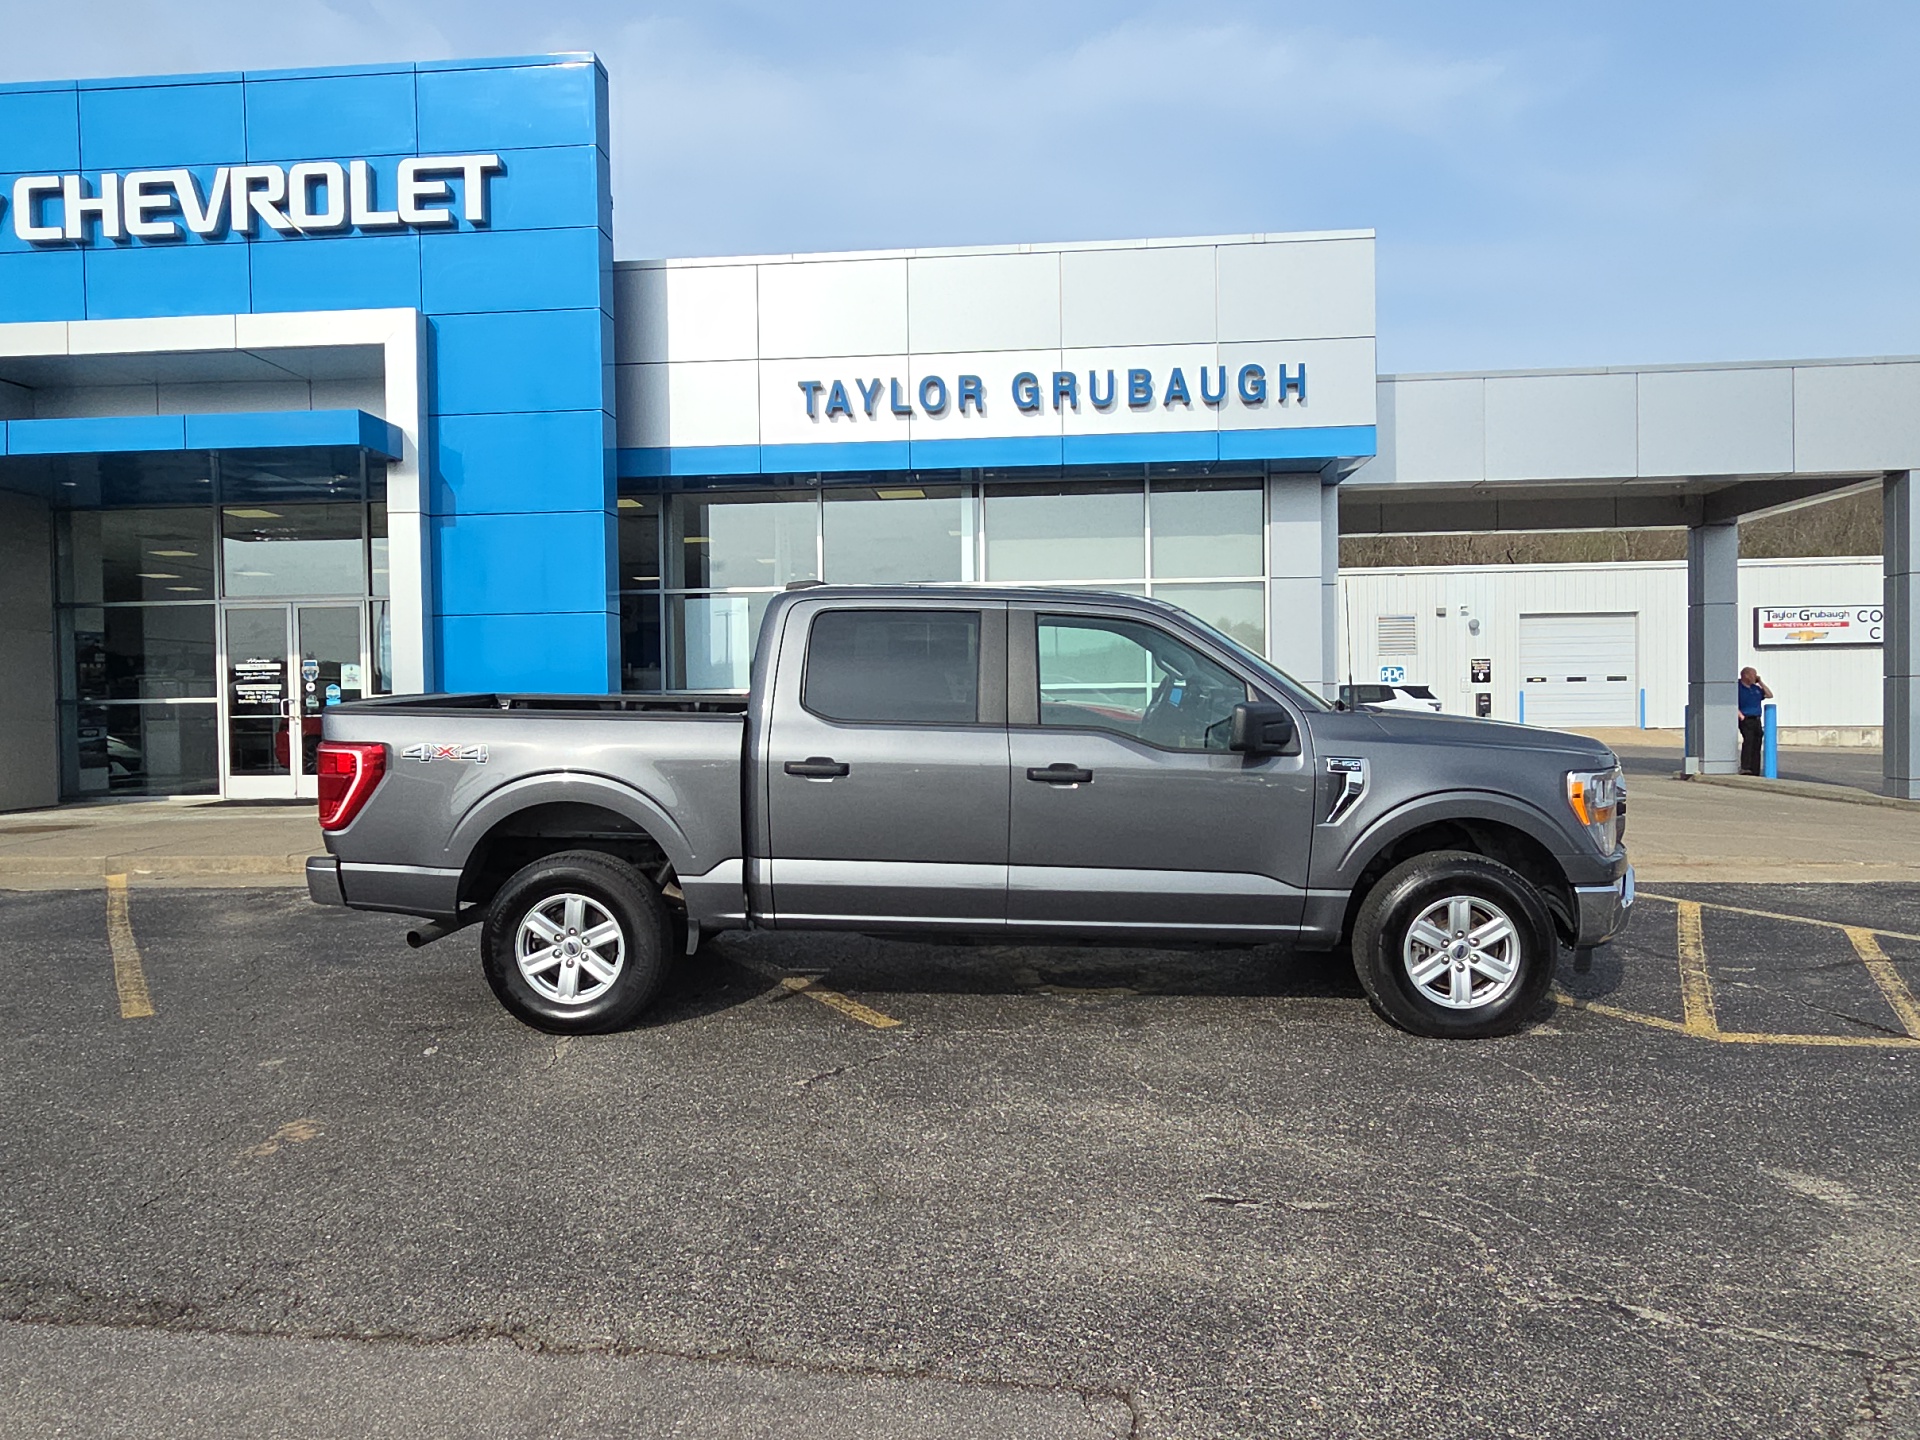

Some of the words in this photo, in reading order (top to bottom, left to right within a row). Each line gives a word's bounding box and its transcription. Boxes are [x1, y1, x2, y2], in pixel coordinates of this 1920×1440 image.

[13, 154, 500, 242] CHEVROLET
[798, 375, 986, 418] TAYLOR
[1012, 363, 1306, 411] GRUBAUGH
[1763, 610, 1797, 621] Taylor
[1799, 609, 1850, 621] Grubaugh
[1381, 668, 1405, 682] PPG
